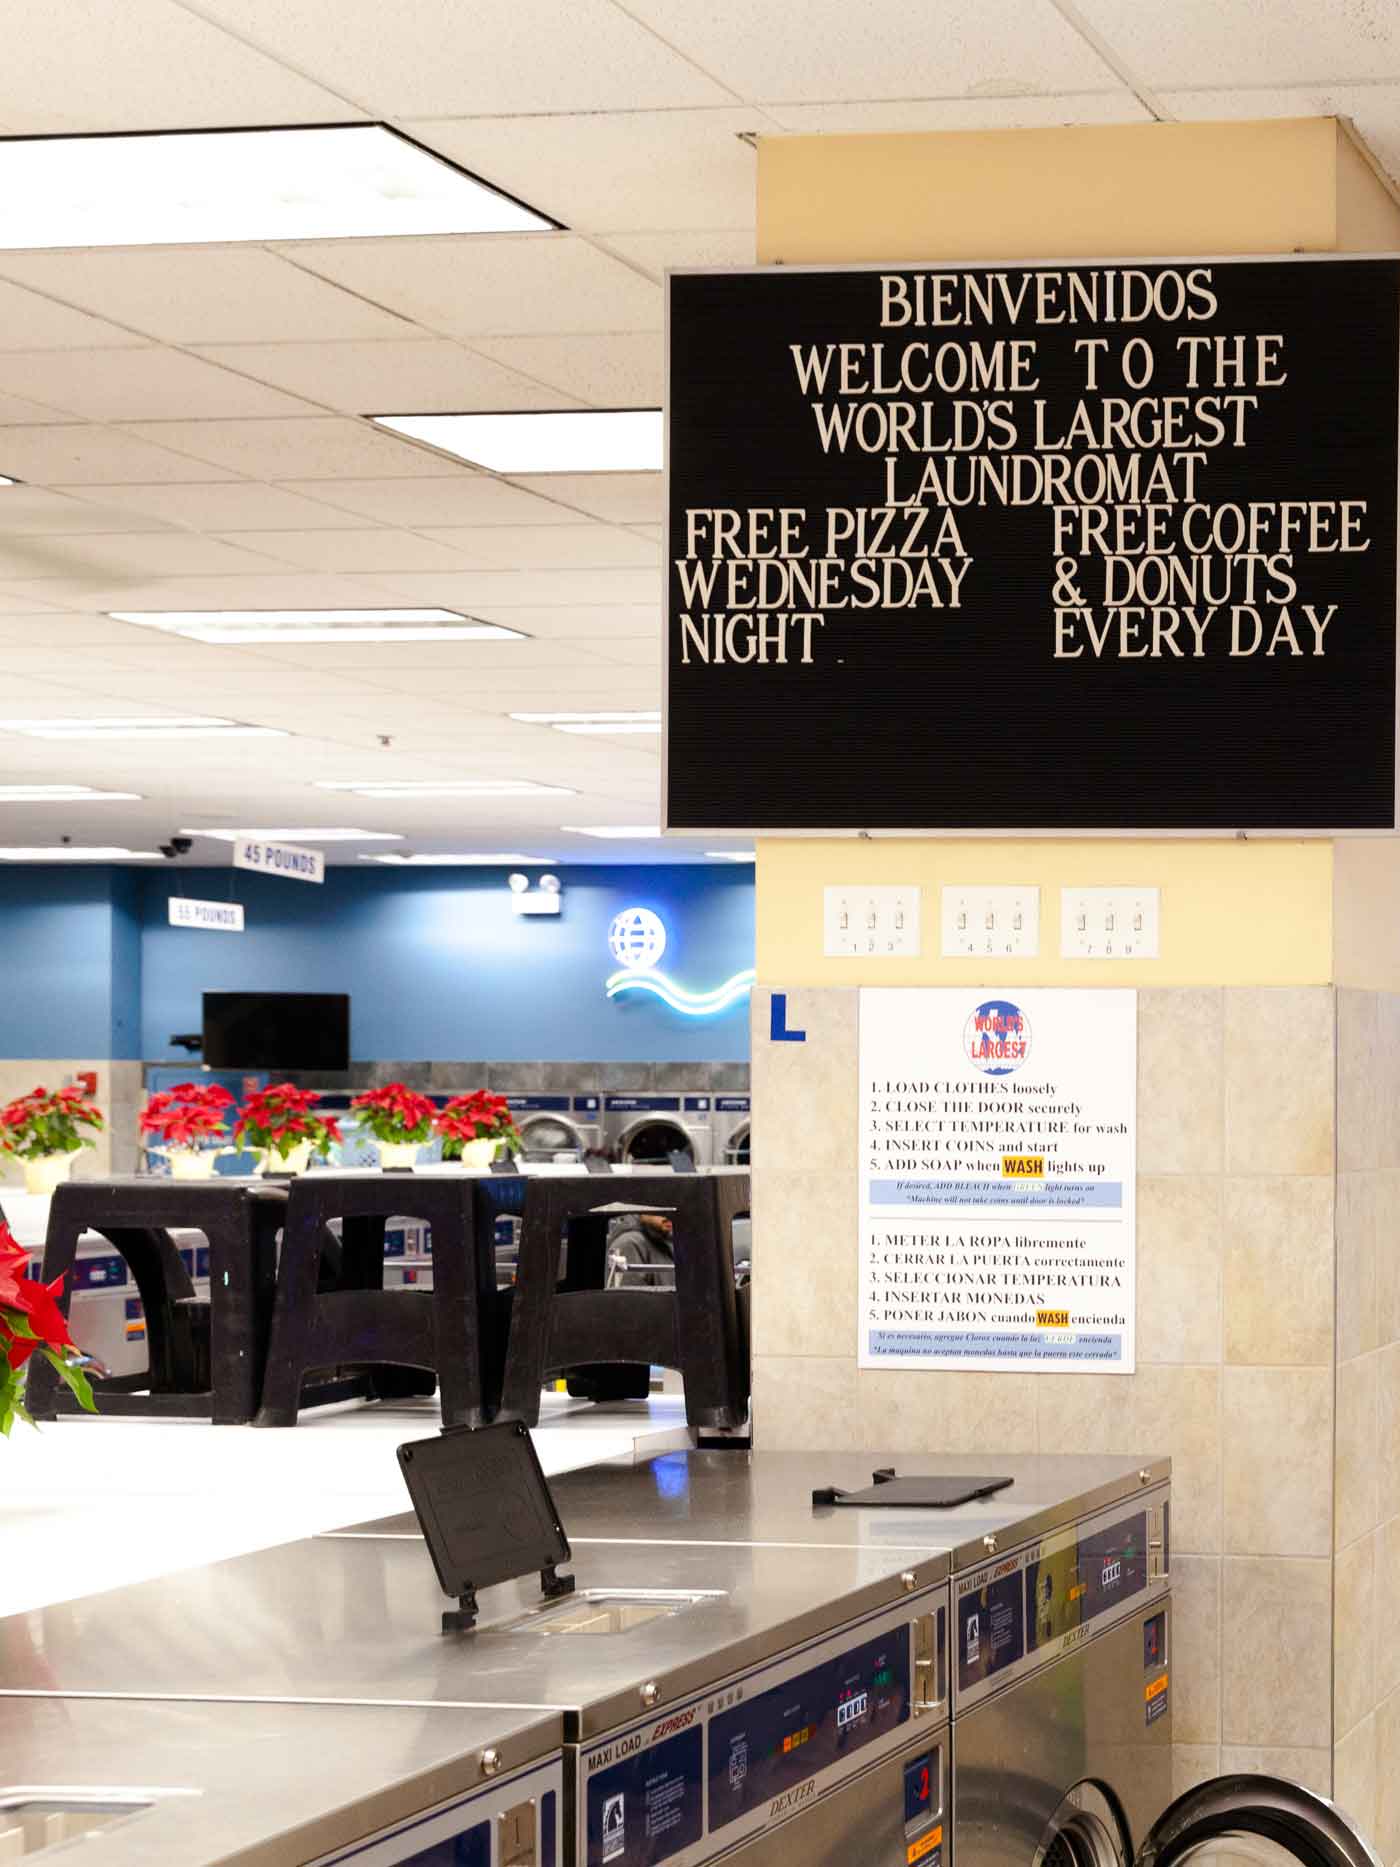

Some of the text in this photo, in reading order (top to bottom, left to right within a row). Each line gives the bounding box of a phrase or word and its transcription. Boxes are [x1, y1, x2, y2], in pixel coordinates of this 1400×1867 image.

[880, 269, 1218, 327] BIENVENIDOS
[789, 334, 1287, 396] WELCOME TO THE
[811, 395, 1258, 454] WORLD'S LARGEST
[885, 452, 1207, 507] LAUNDROMAT
[685, 507, 968, 559] FREE PIZZA
[1052, 500, 1371, 556] FREE COFFEE
[675, 557, 974, 609] WEDNESDAY
[1051, 553, 1297, 607] & DONUTS
[679, 613, 825, 664] NIGHT
[1053, 604, 1339, 659] EVERY DAY
[244, 844, 317, 876] 45 POUNDS
[769, 993, 807, 1042] L
[974, 1014, 1025, 1034] WORLD'S
[970, 1039, 1028, 1060] LARGEST
[871, 1081, 1057, 1098] 1. LOAD CLOTHES loosely
[870, 1101, 1083, 1117] 2. CLOSE THE DOOR securely
[869, 1120, 1128, 1135] 3. SELECT TEMPERATURE for wash
[869, 1139, 1059, 1153] 4. INSERT COINS and start
[869, 1158, 1105, 1175] 5. ADD SOAP when WASH lights up
[870, 1235, 1087, 1249] 1. METER LA ROPA libremente
[869, 1253, 1126, 1268] 2. CERRAR LA PUERTA correctamente
[869, 1272, 1122, 1287] 3. SELECCIONAR TEMPERATURA
[869, 1291, 1046, 1305] 4. INSERTAR MONEDAS
[869, 1310, 1126, 1326] 5. PONER JABON cuando WASH encienda
[973, 1571, 988, 1589] LOAD
[587, 1708, 697, 1771] MAXI LOAD EXPRESS
[769, 1779, 816, 1817] DEXTER
